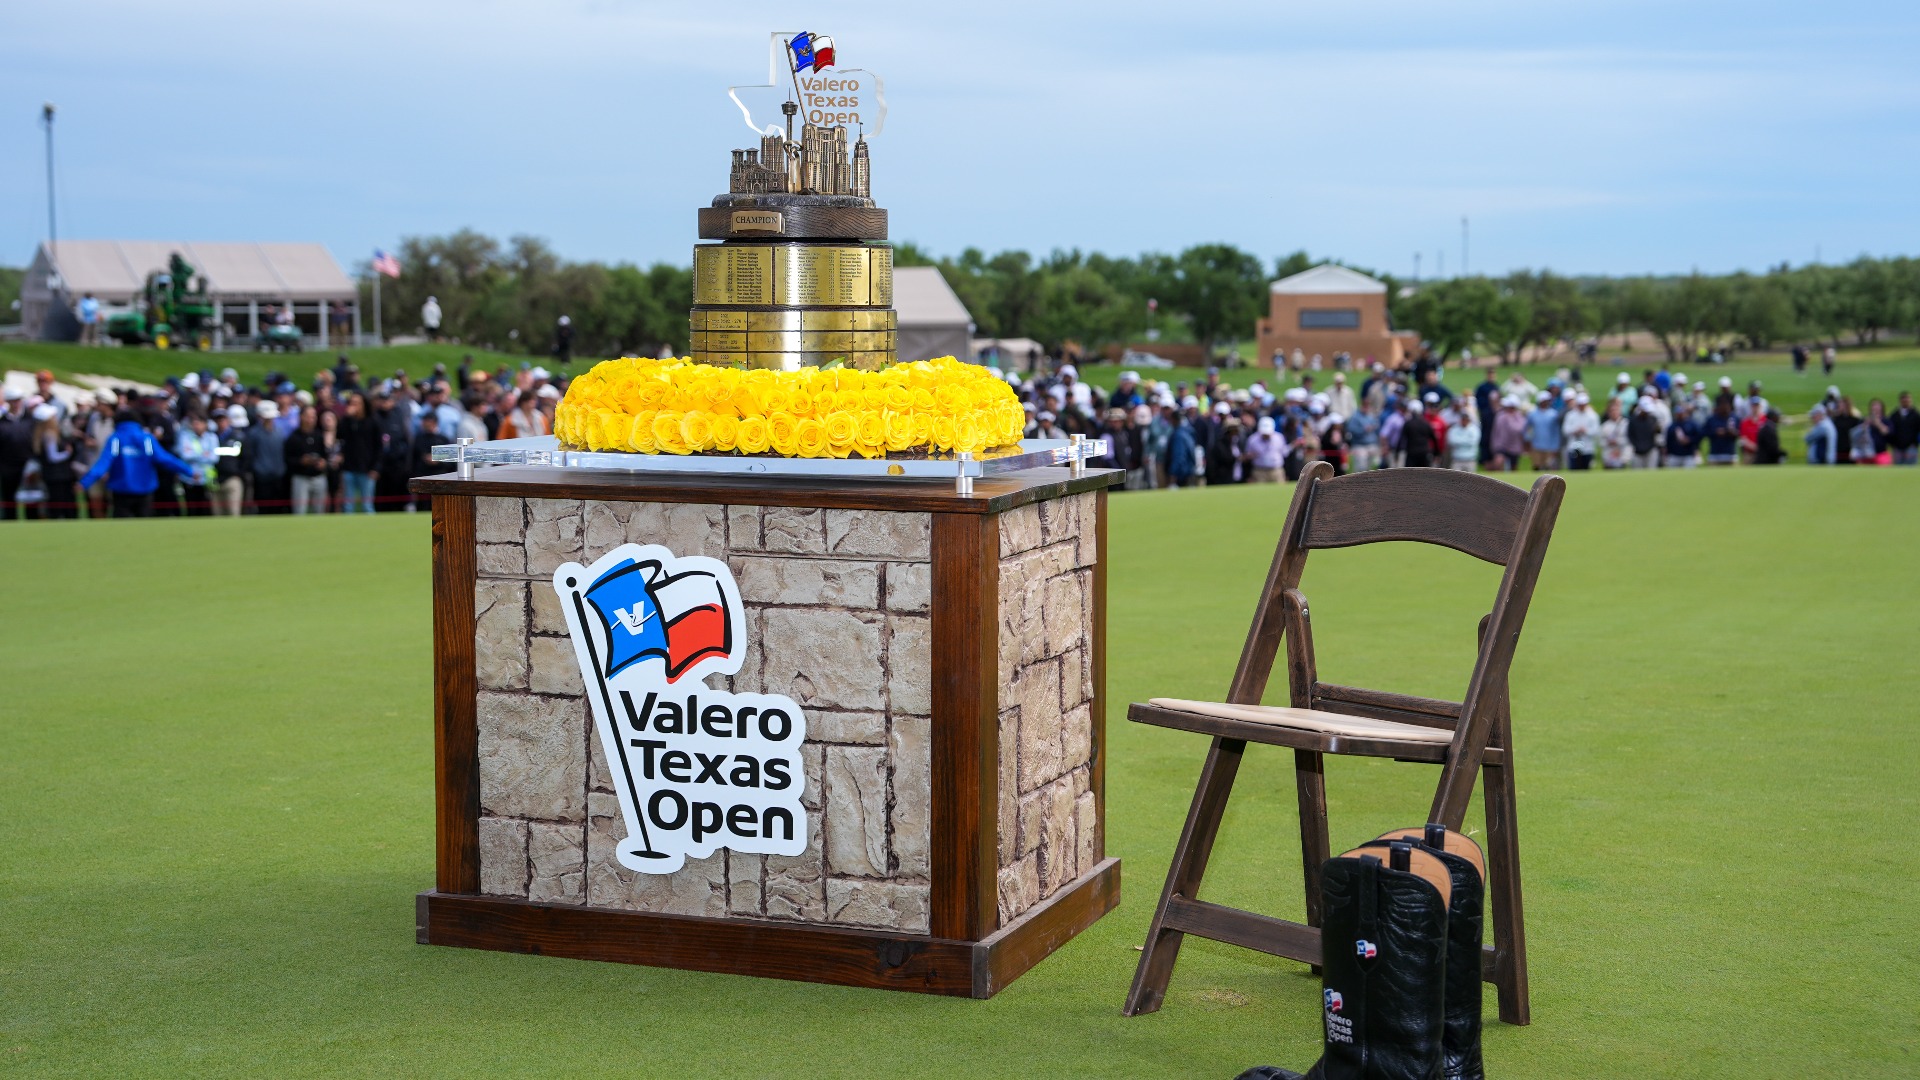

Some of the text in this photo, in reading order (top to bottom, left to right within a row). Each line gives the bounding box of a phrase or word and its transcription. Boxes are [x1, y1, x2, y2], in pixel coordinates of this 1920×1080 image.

[801, 77, 859, 91] Valero
[804, 93, 859, 107] Texas
[810, 109, 859, 127] Open
[736, 216, 777, 224] CHAMPION
[619, 690, 792, 741] Valero
[631, 739, 792, 790] Texas
[648, 789, 794, 843] Open
[1329, 1030, 1353, 1043] Open
